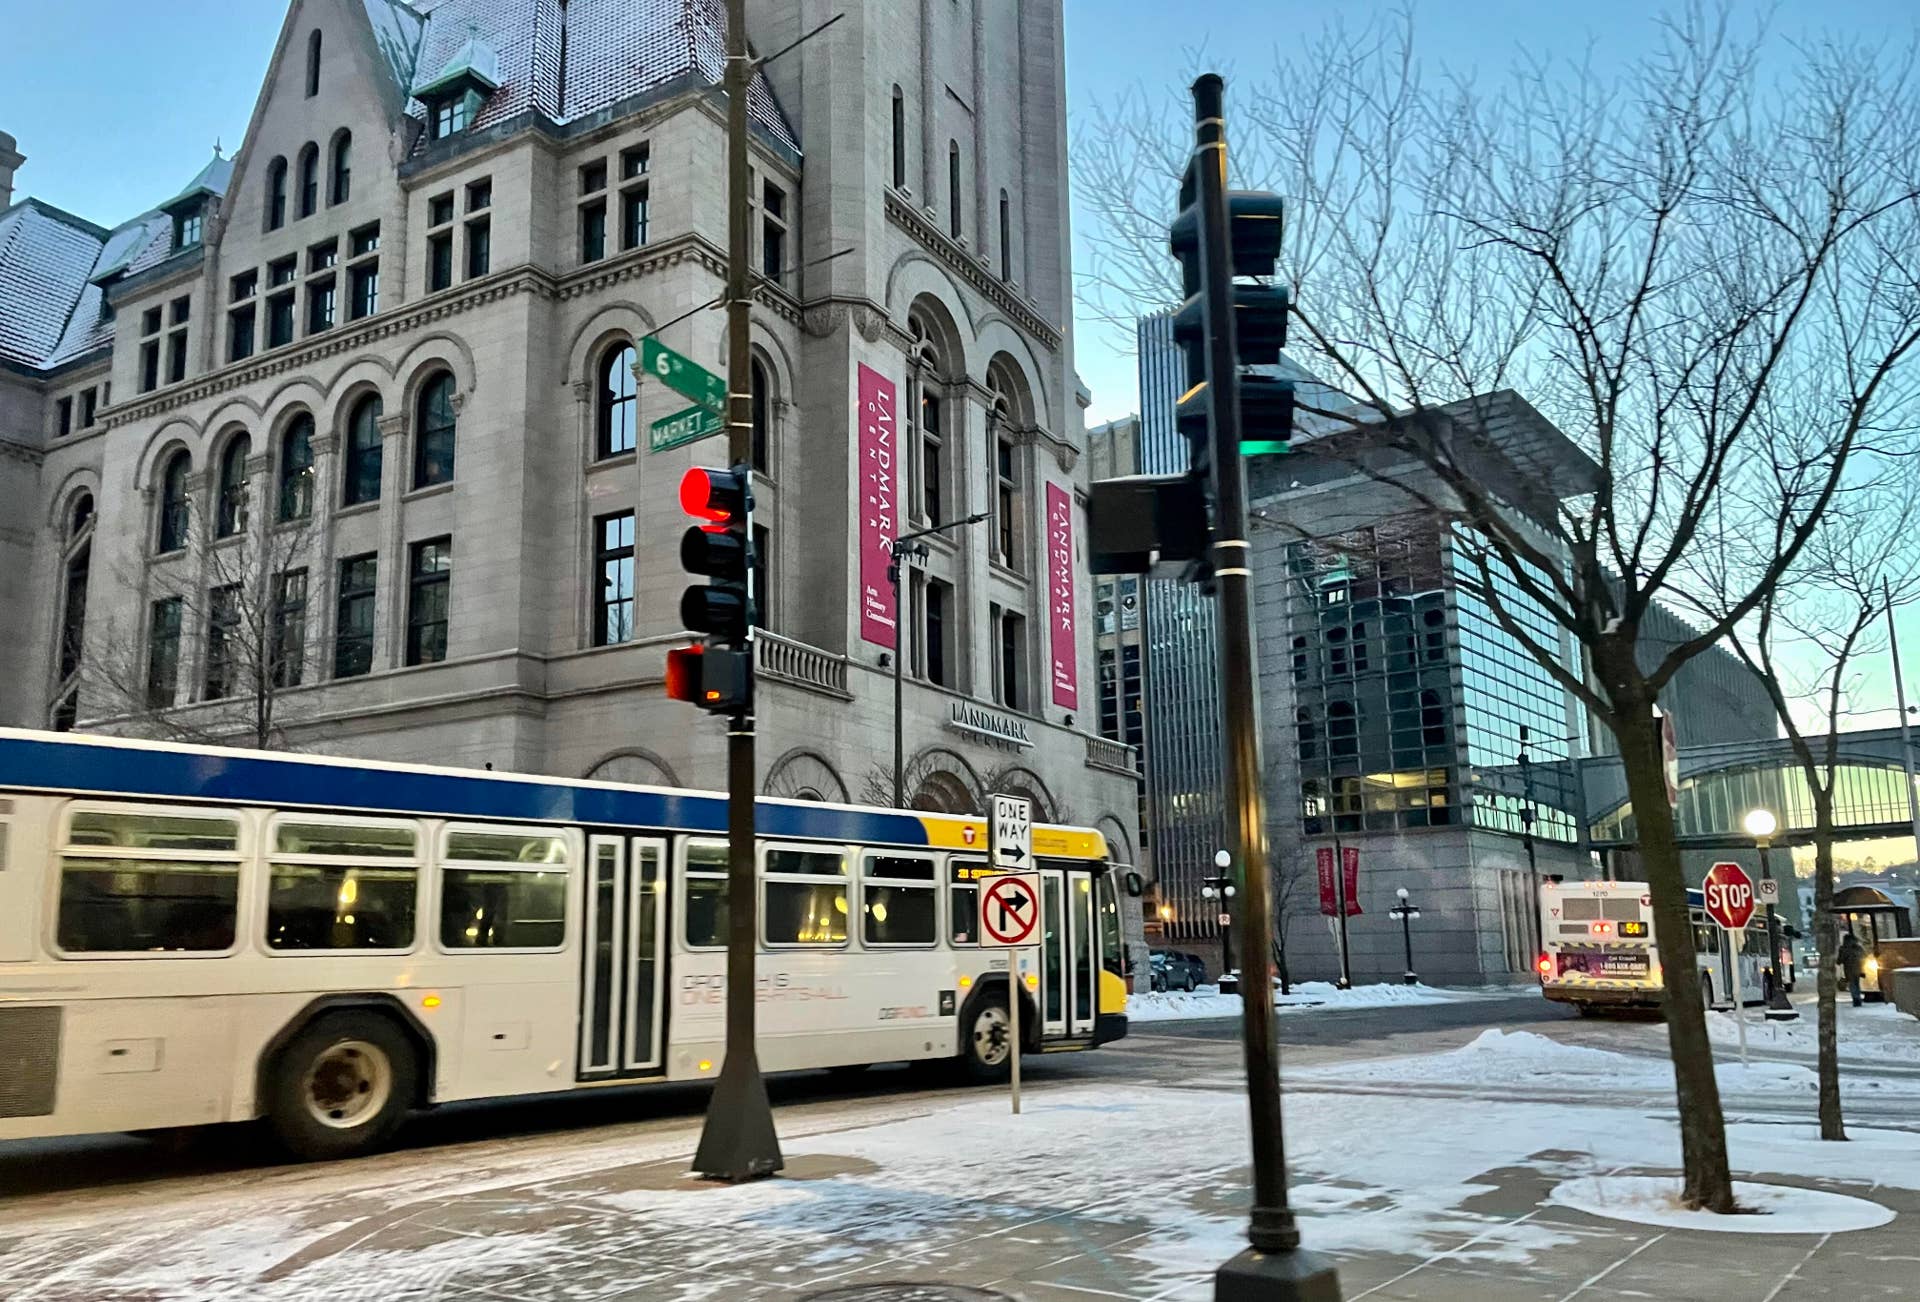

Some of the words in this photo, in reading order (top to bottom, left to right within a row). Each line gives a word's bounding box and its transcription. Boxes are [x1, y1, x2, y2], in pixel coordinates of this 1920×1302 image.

[652, 411, 702, 447] MARKET
[868, 402, 878, 527] CENTER
[877, 389, 893, 554] LANDMARK
[1058, 501, 1072, 631] LANDMARK
[952, 700, 1030, 742] LANDMARK
[998, 801, 1027, 821] ONE
[998, 821, 1028, 840] WAY
[1708, 883, 1751, 909] STOP
[1625, 923, 1641, 934] 54
